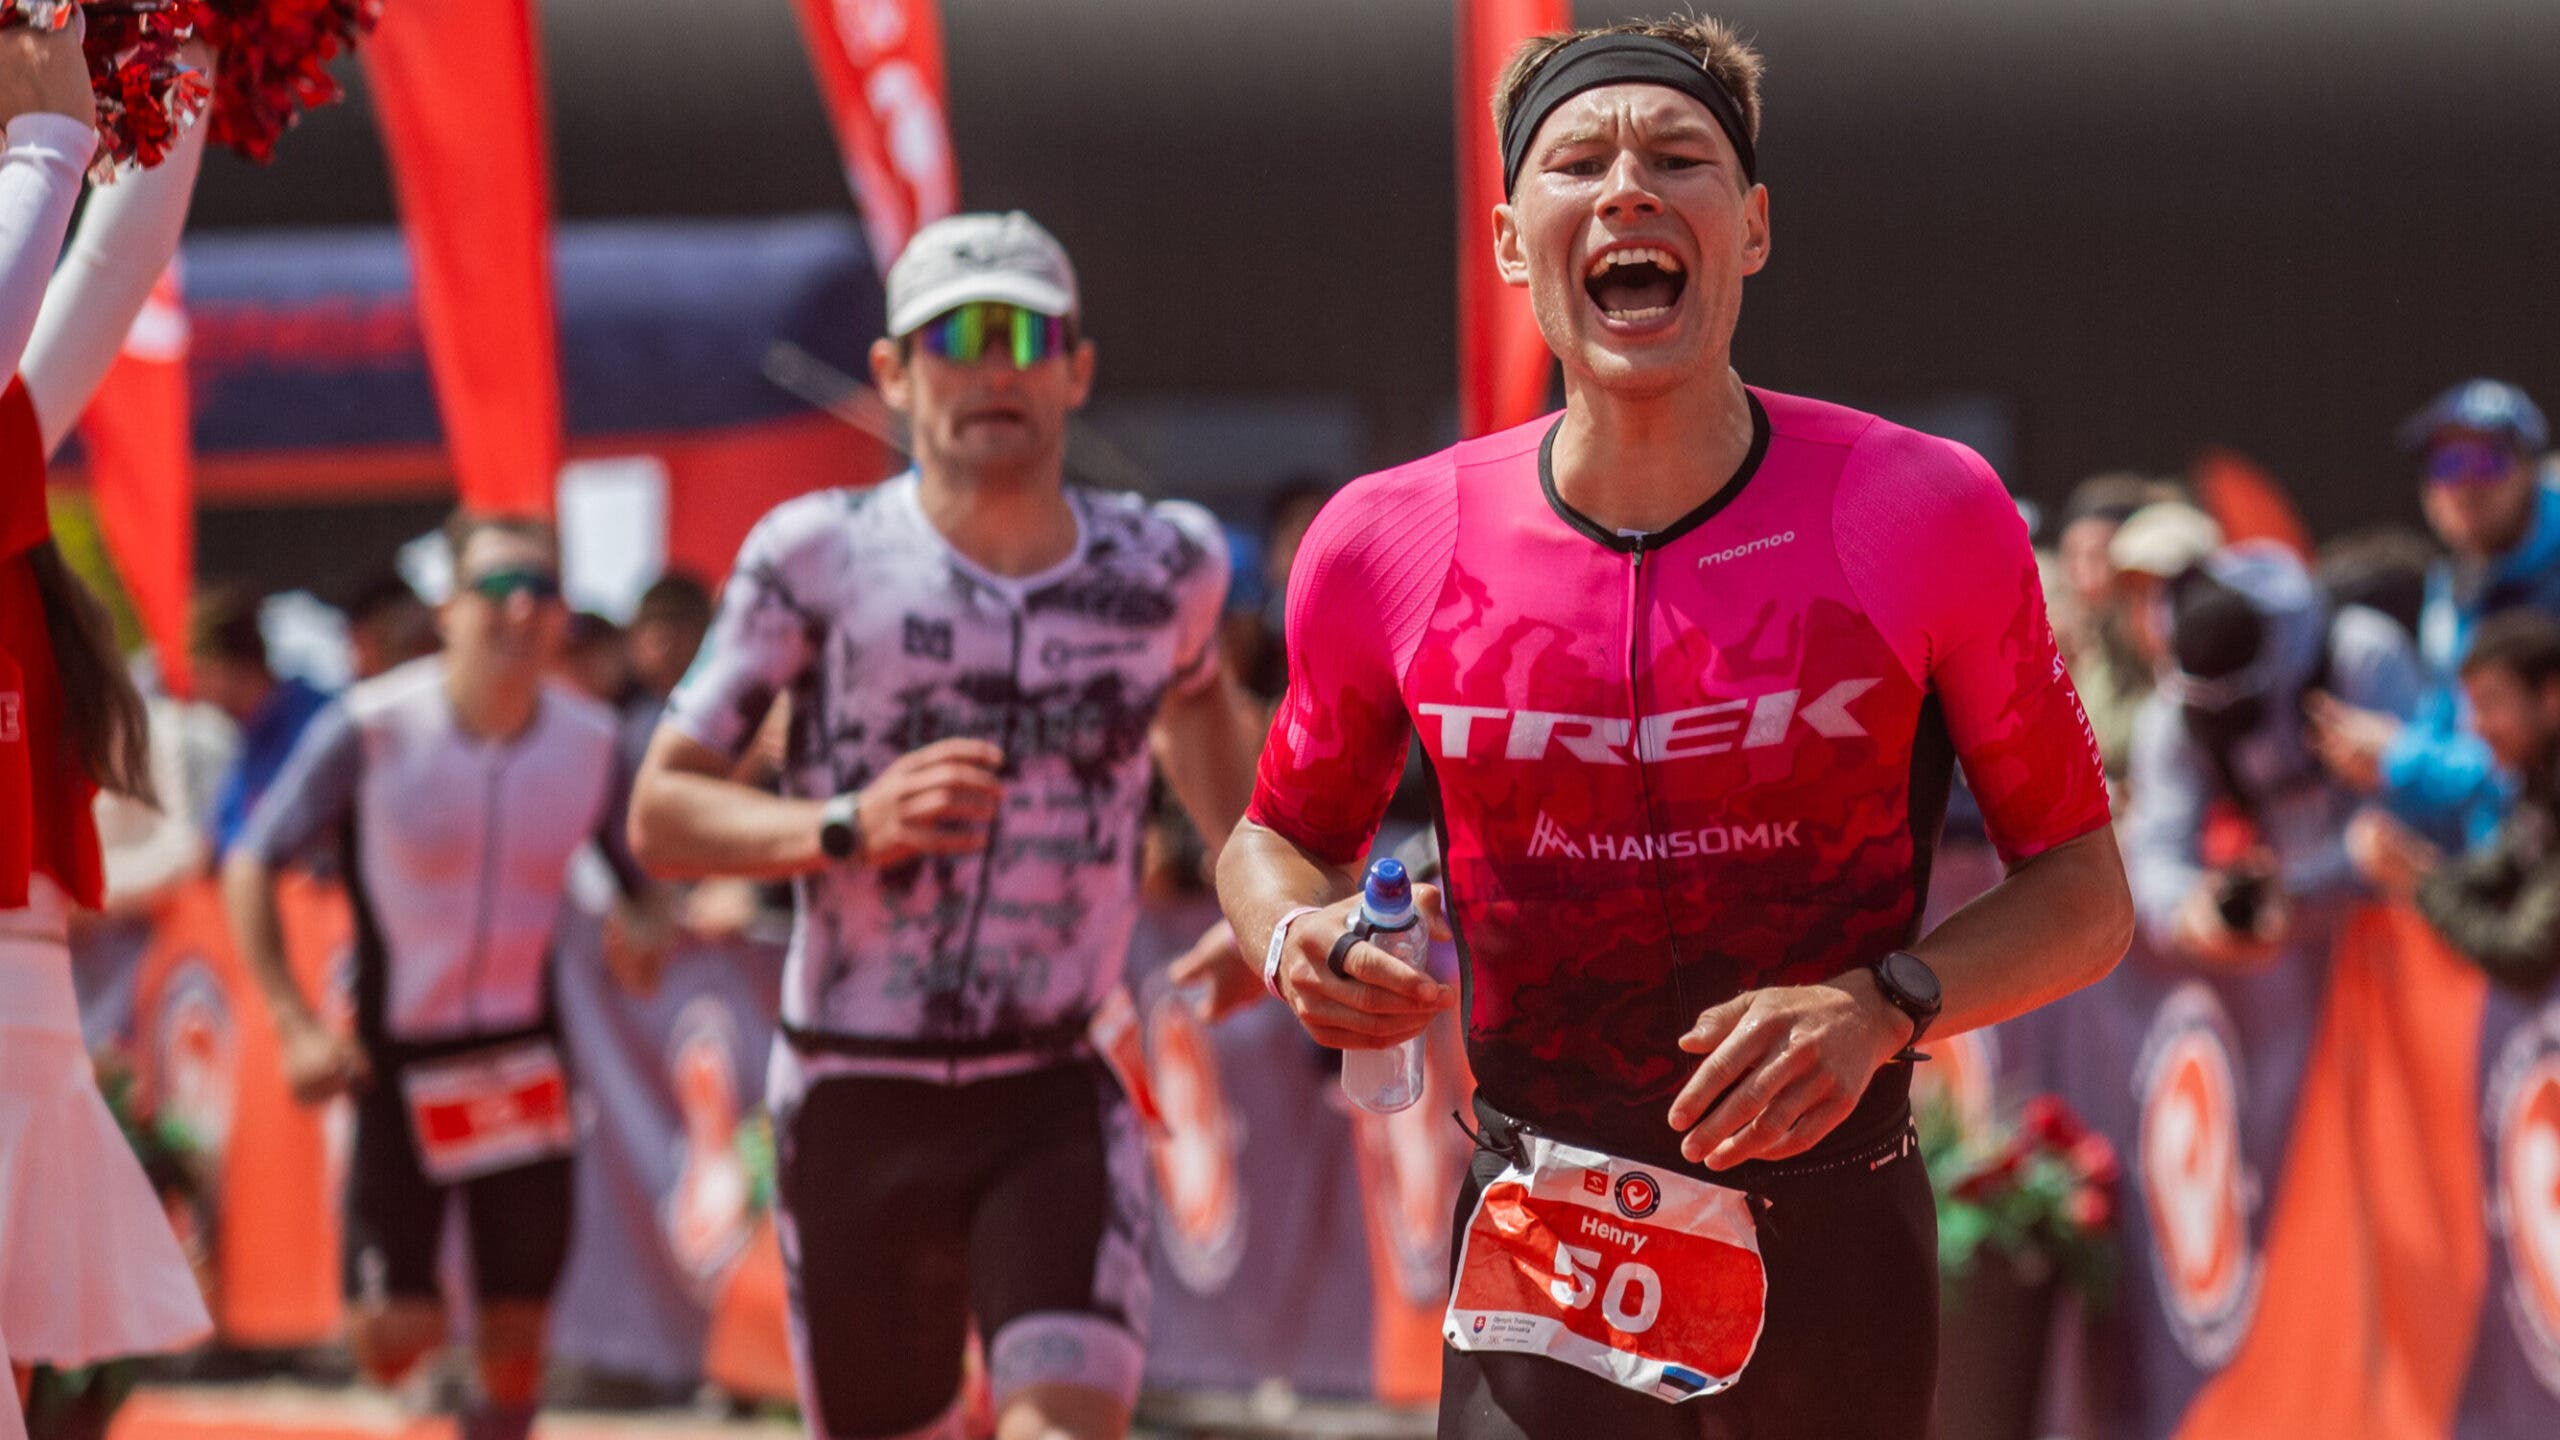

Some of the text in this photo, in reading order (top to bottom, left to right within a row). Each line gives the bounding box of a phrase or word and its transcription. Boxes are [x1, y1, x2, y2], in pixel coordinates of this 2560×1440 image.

[1698, 530, 1796, 570] moomoo
[1417, 677, 1884, 766] TREK
[2065, 689, 2106, 788] HENRY
[1588, 820, 1801, 862] HANSOMK
[1580, 1215, 1649, 1255] Henry
[1550, 1240, 1662, 1334] 50
